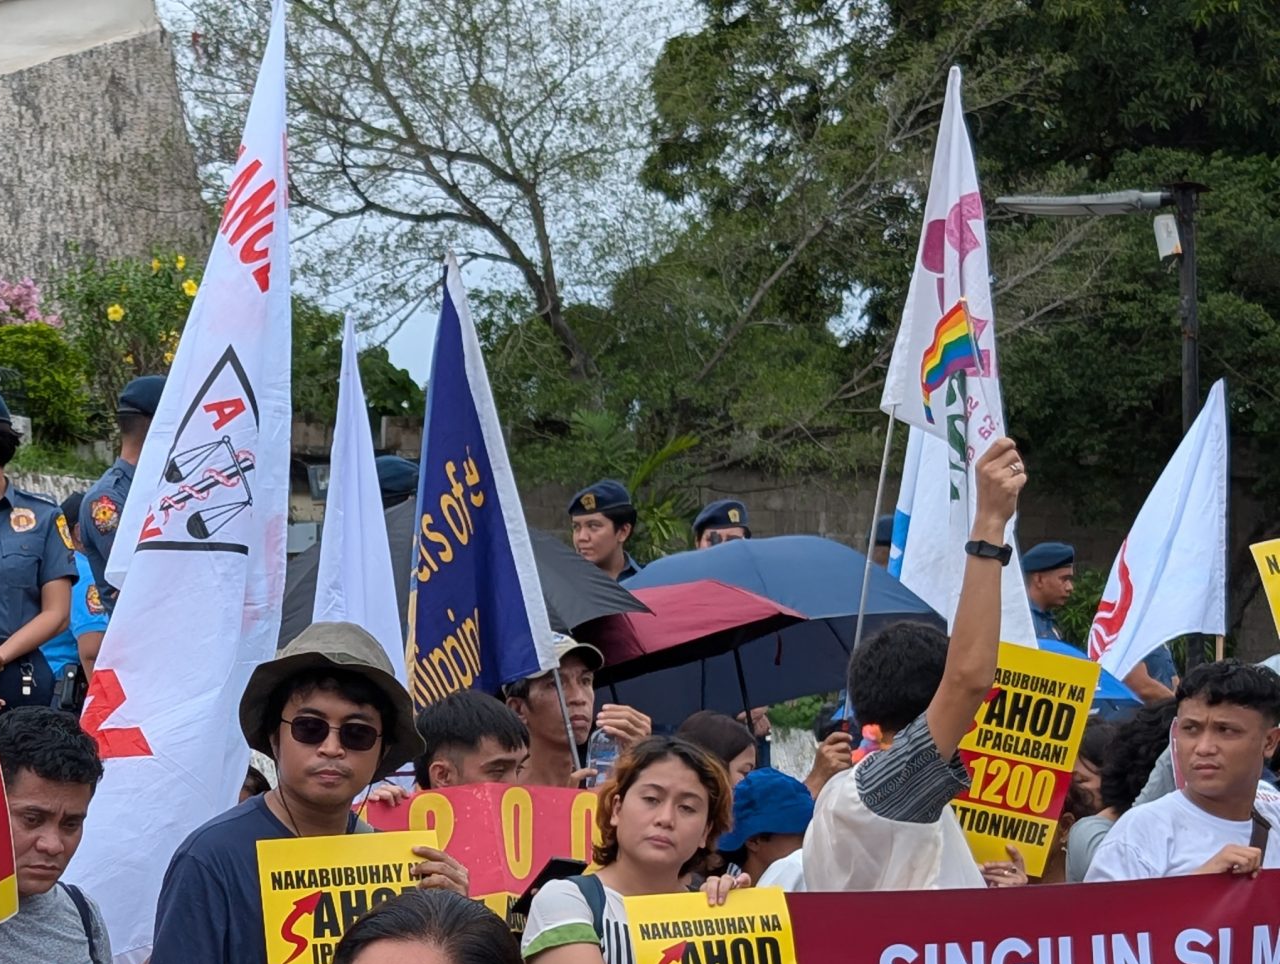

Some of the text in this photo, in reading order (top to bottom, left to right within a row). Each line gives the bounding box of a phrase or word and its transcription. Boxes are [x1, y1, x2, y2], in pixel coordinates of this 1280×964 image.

[1067, 685, 1086, 703] NA
[983, 688, 1076, 741] AHOD
[976, 727, 1068, 765] IPAGLABAN!
[271, 862, 403, 891] NAKABUBUHAY
[639, 914, 782, 941] NAKABUBUHAY NA
